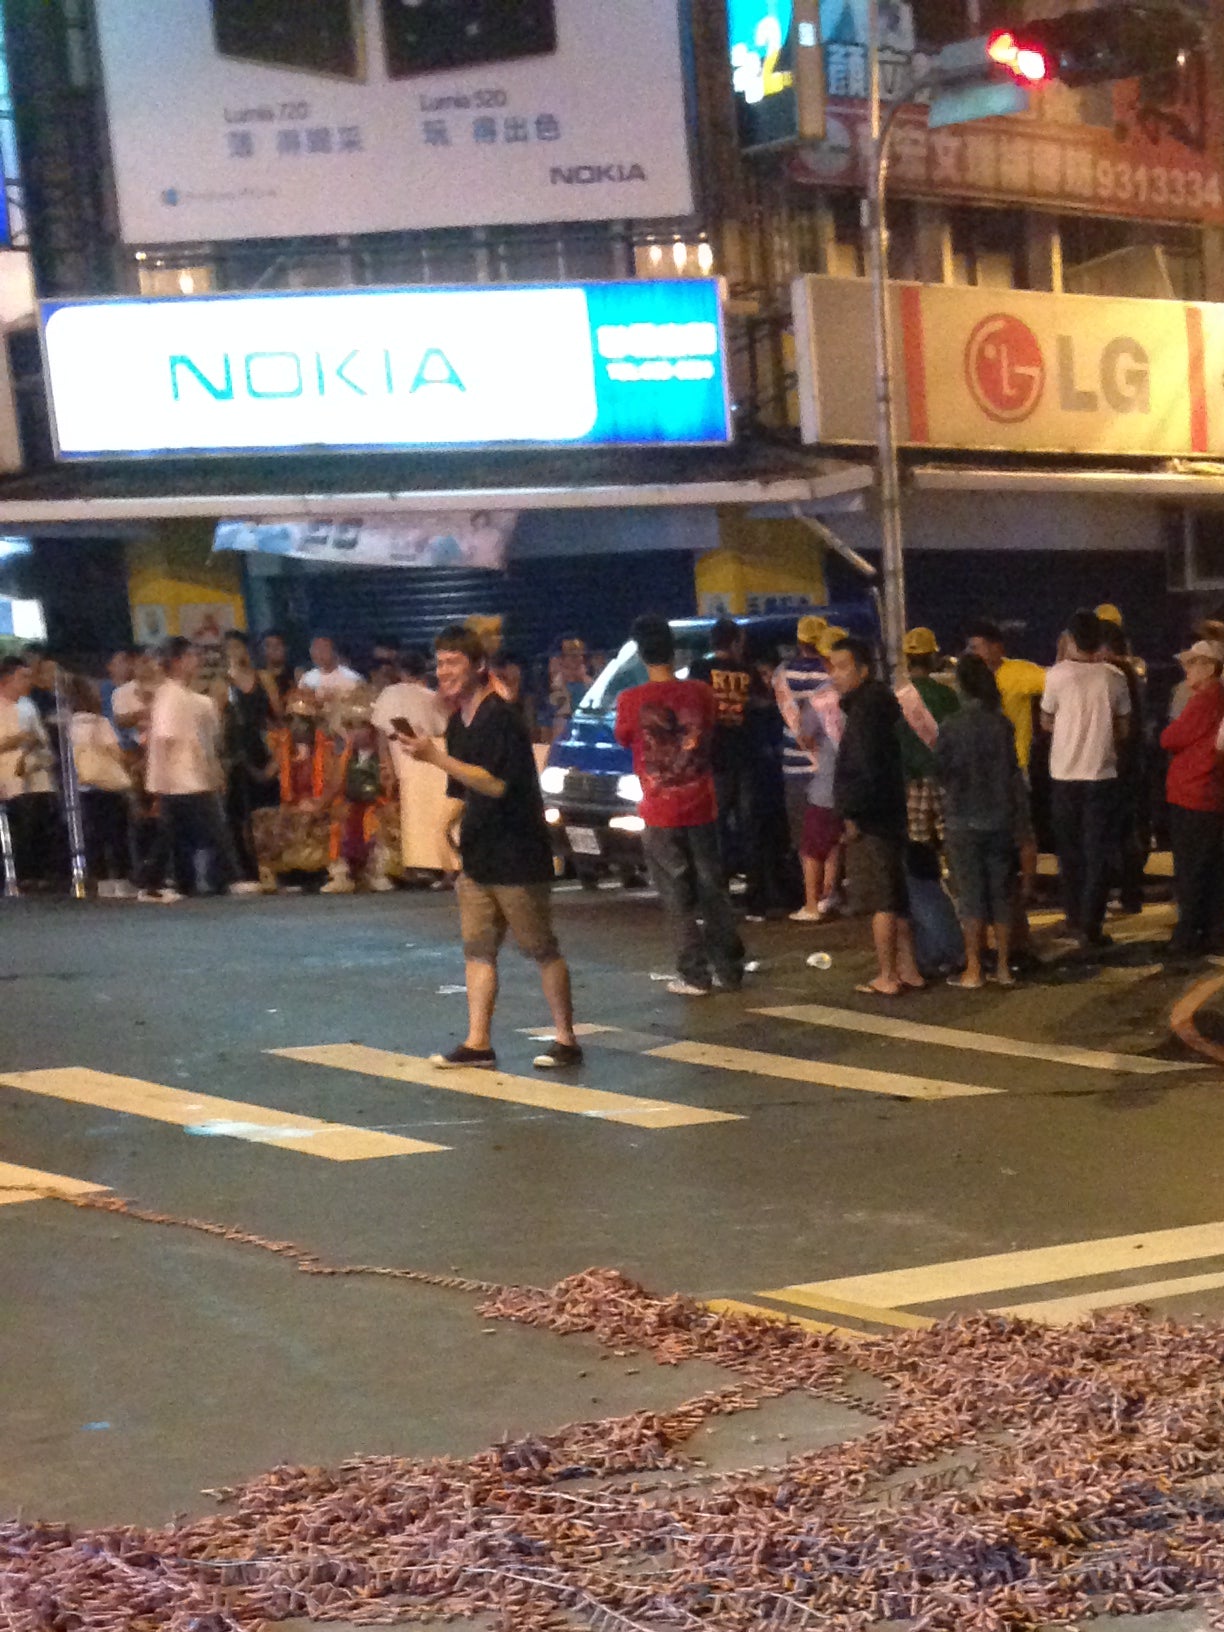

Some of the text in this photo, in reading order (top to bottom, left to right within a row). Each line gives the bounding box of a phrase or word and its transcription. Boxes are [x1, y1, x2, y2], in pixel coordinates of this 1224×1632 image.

[550, 162, 647, 185] NOKIA
[1096, 160, 1223, 208] 9313334
[168, 347, 467, 401] NOKIA
[1056, 333, 1151, 415] LG
